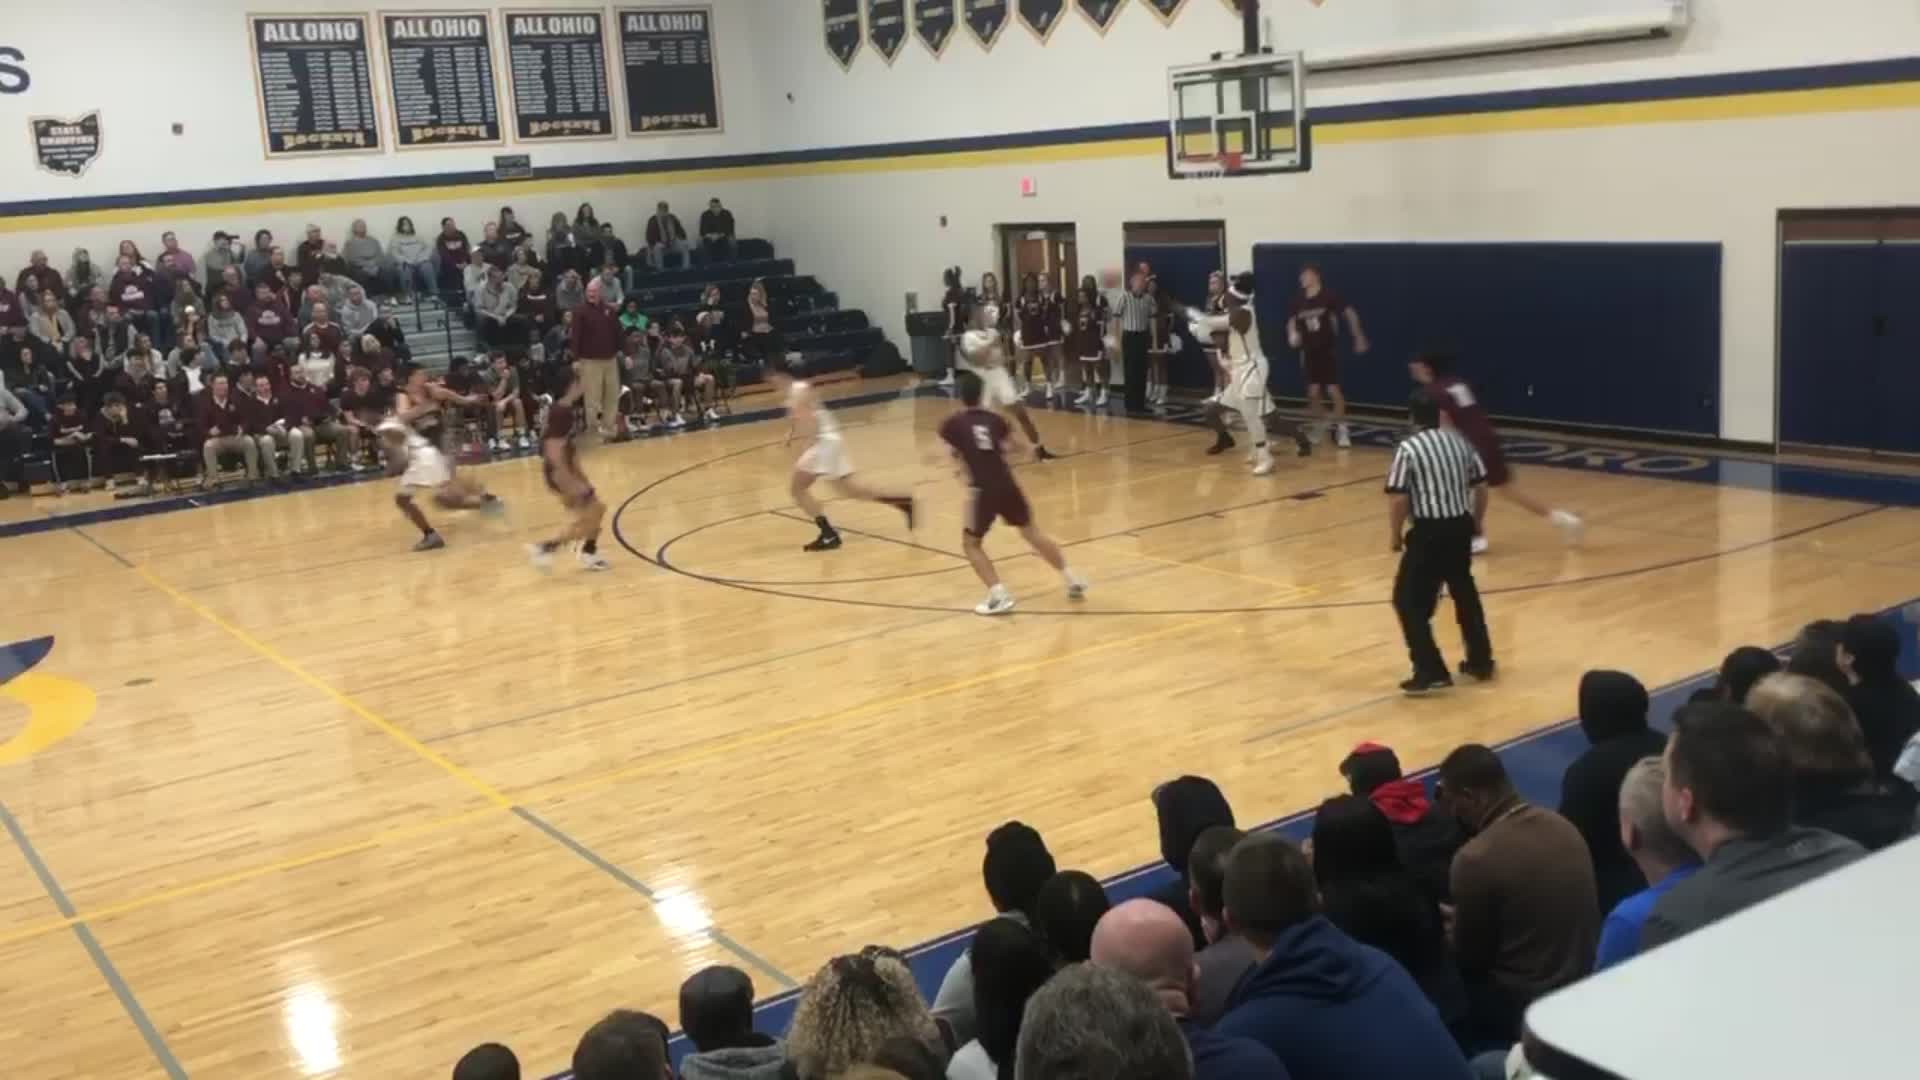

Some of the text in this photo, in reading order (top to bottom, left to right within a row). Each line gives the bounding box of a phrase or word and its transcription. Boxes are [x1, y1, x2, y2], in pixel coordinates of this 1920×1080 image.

[264, 22, 360, 42] ALL OHIO
[393, 18, 483, 38] ALL OHIO
[514, 15, 597, 35] ALL OHIO
[627, 14, 704, 32] ALL OHIO
